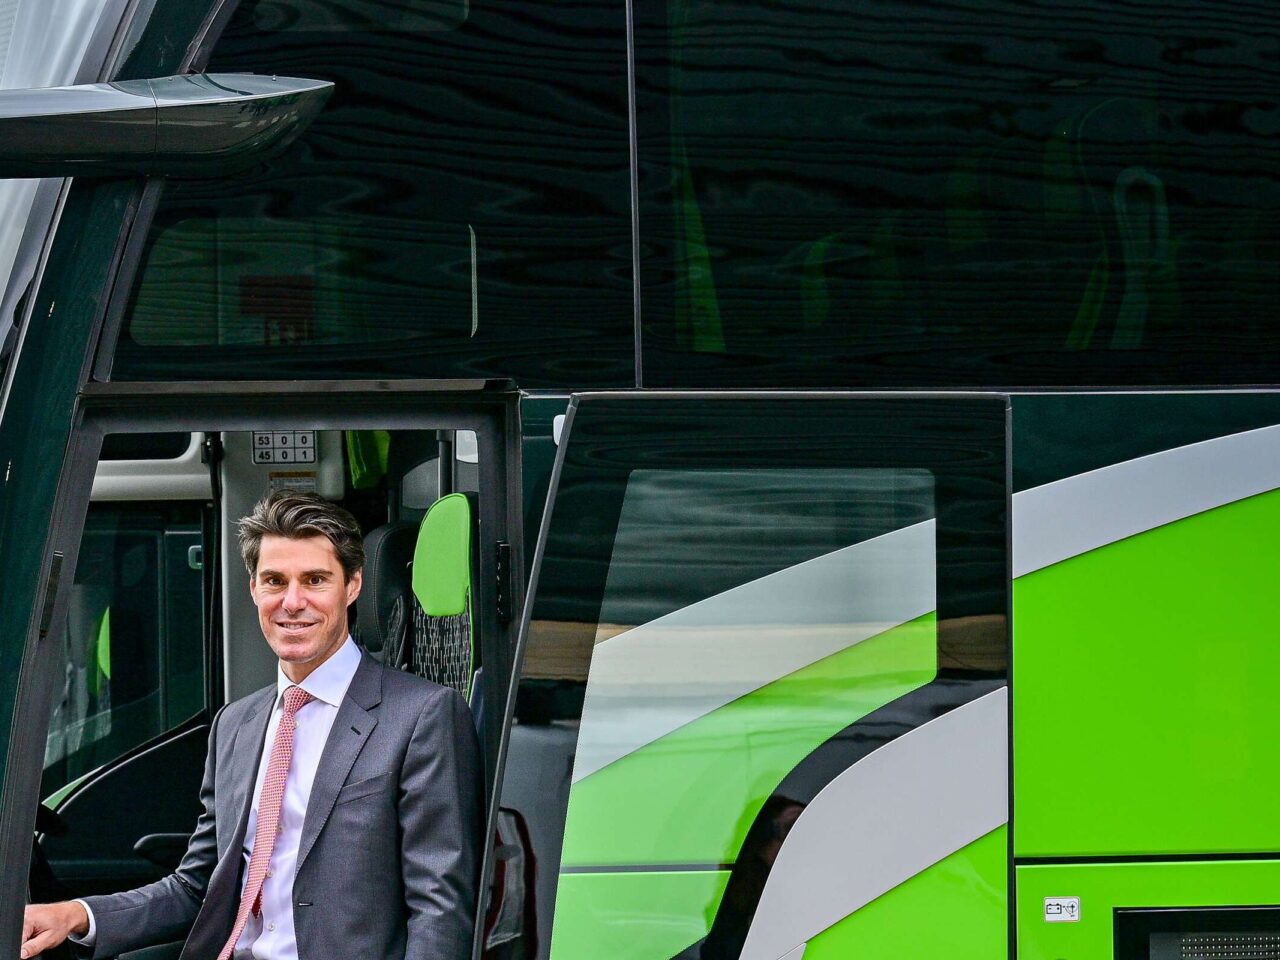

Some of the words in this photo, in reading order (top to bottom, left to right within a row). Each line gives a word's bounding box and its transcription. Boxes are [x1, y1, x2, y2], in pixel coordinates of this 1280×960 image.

[258, 436, 270, 445] 53
[281, 436, 287, 445] 0
[301, 435, 307, 444] 0
[258, 451, 270, 460] 45
[281, 451, 287, 460] 0
